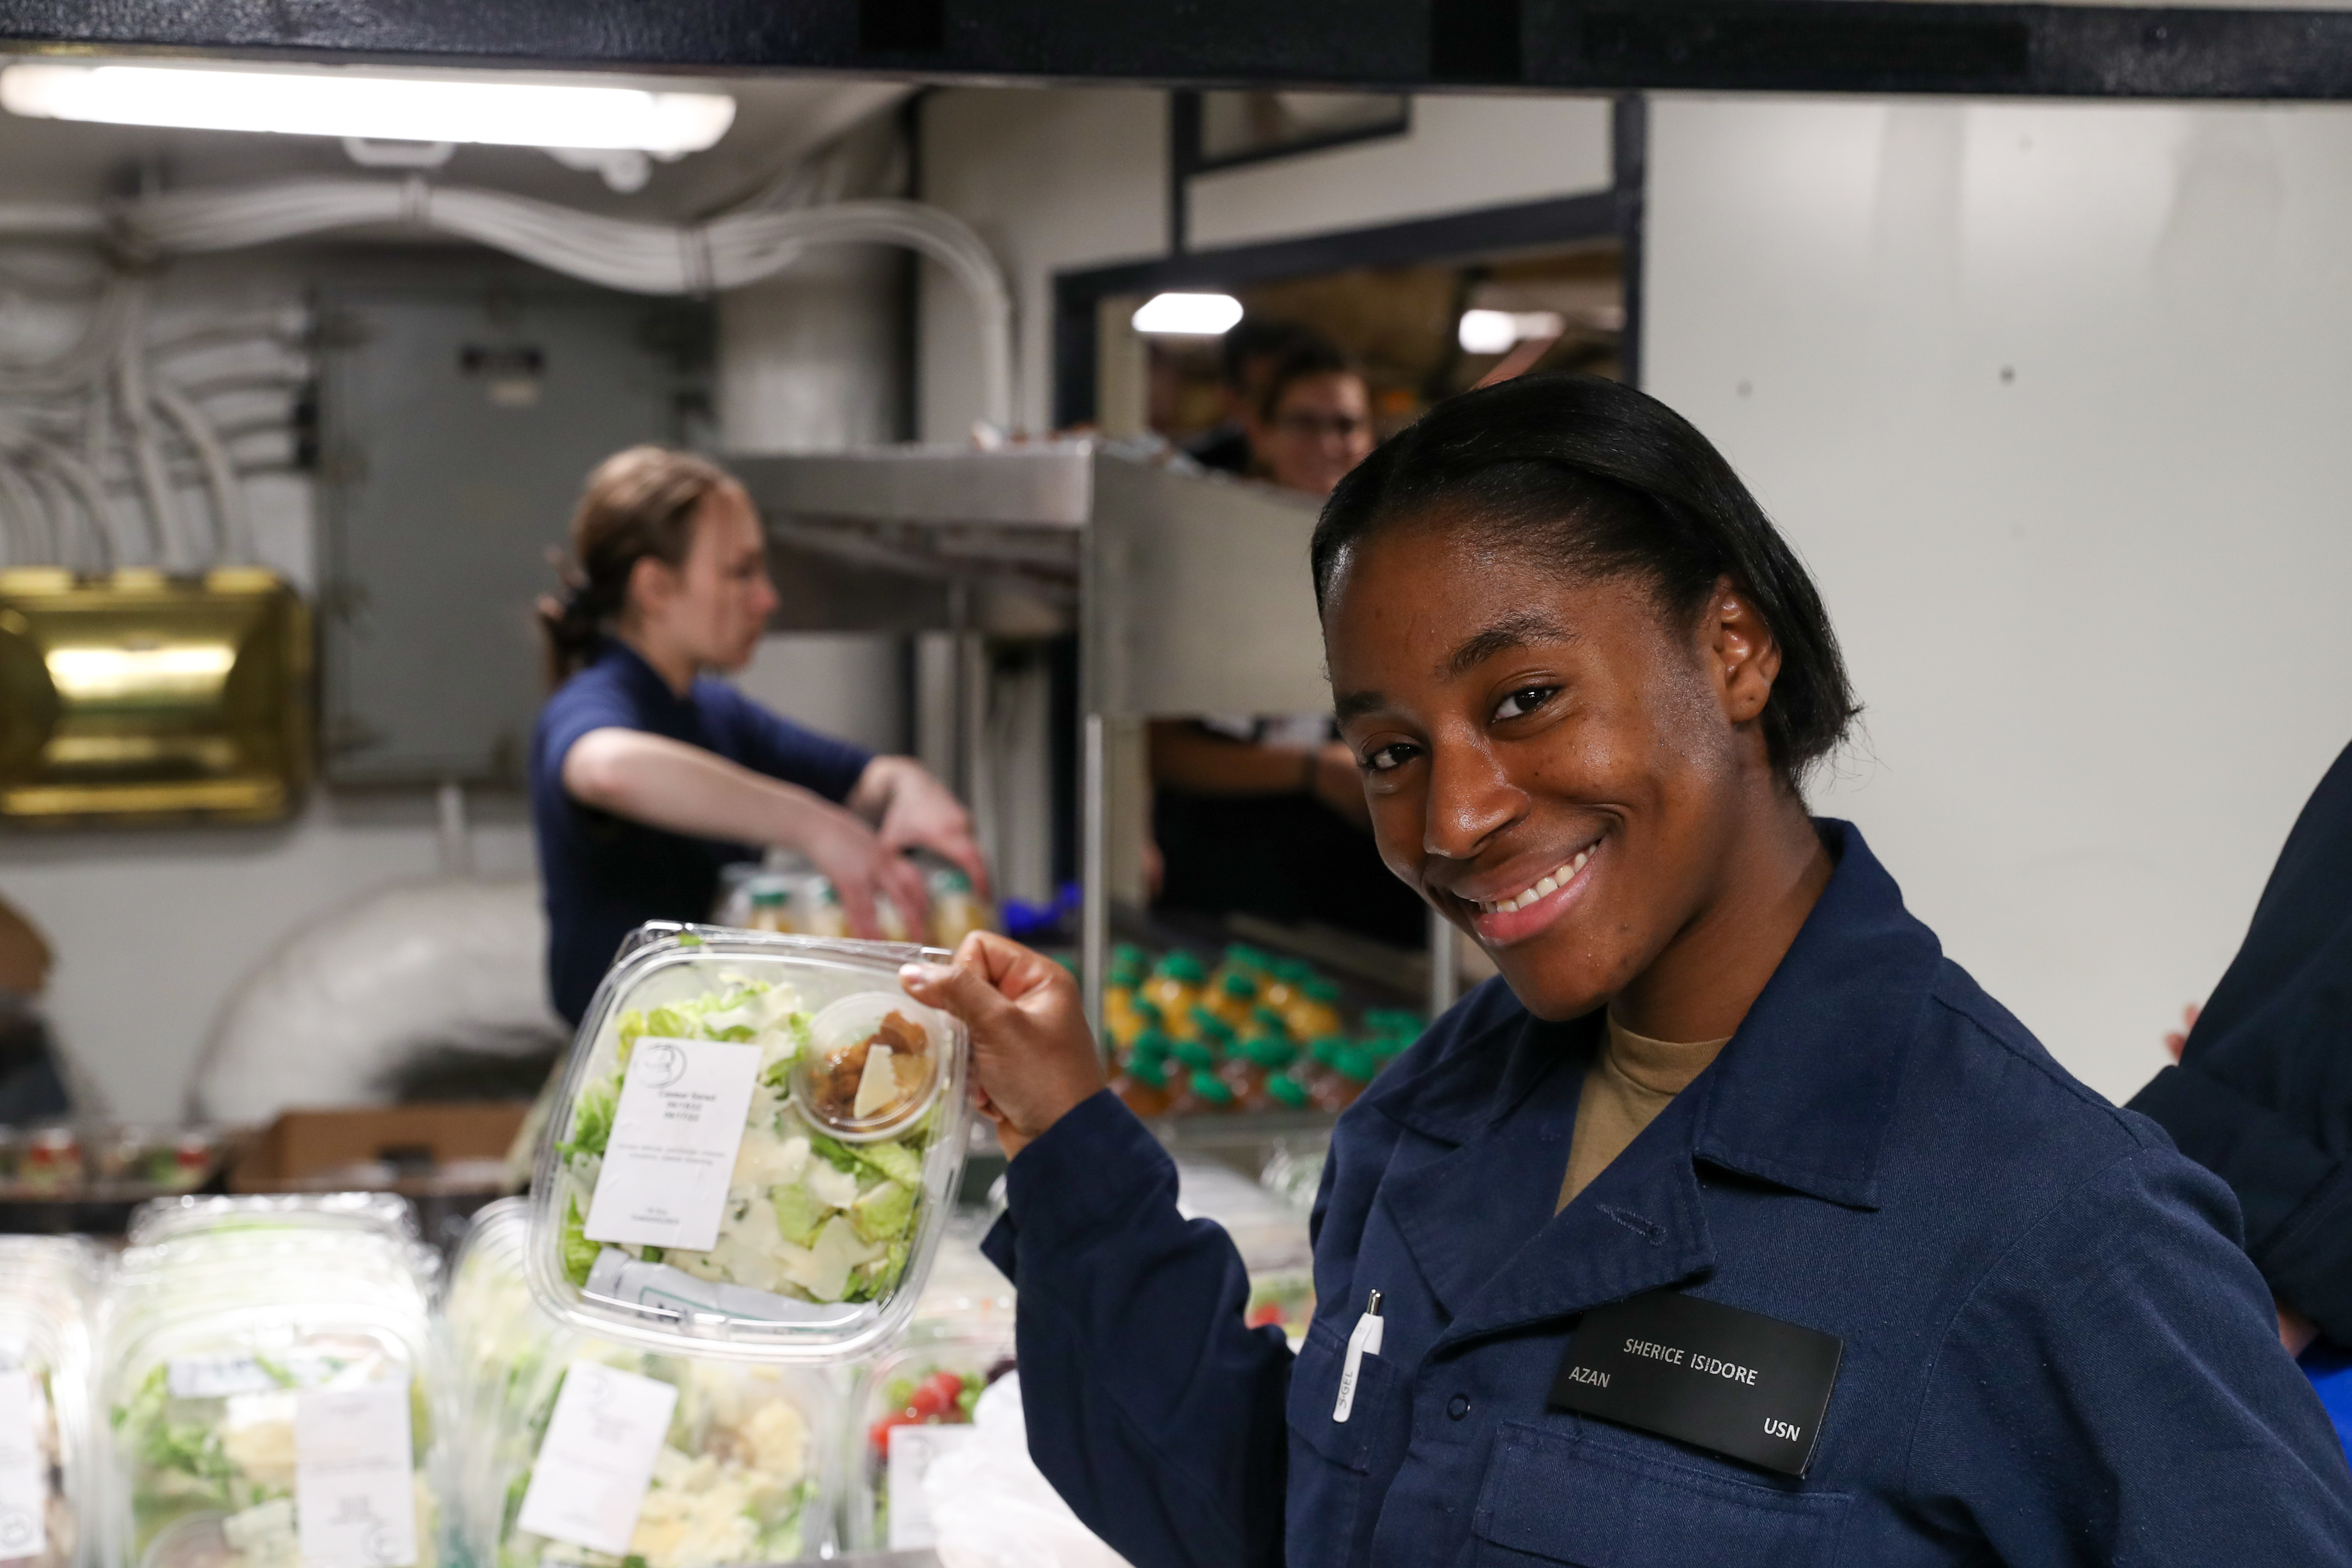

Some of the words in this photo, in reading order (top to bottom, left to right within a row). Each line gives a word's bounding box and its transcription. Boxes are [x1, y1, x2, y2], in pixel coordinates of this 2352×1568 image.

[1624, 1338, 1684, 1365] SHERICE
[1690, 1353, 1758, 1386] ISIDORE
[1568, 1367, 1610, 1388] AZAN
[1764, 1417, 1800, 1441] USN
